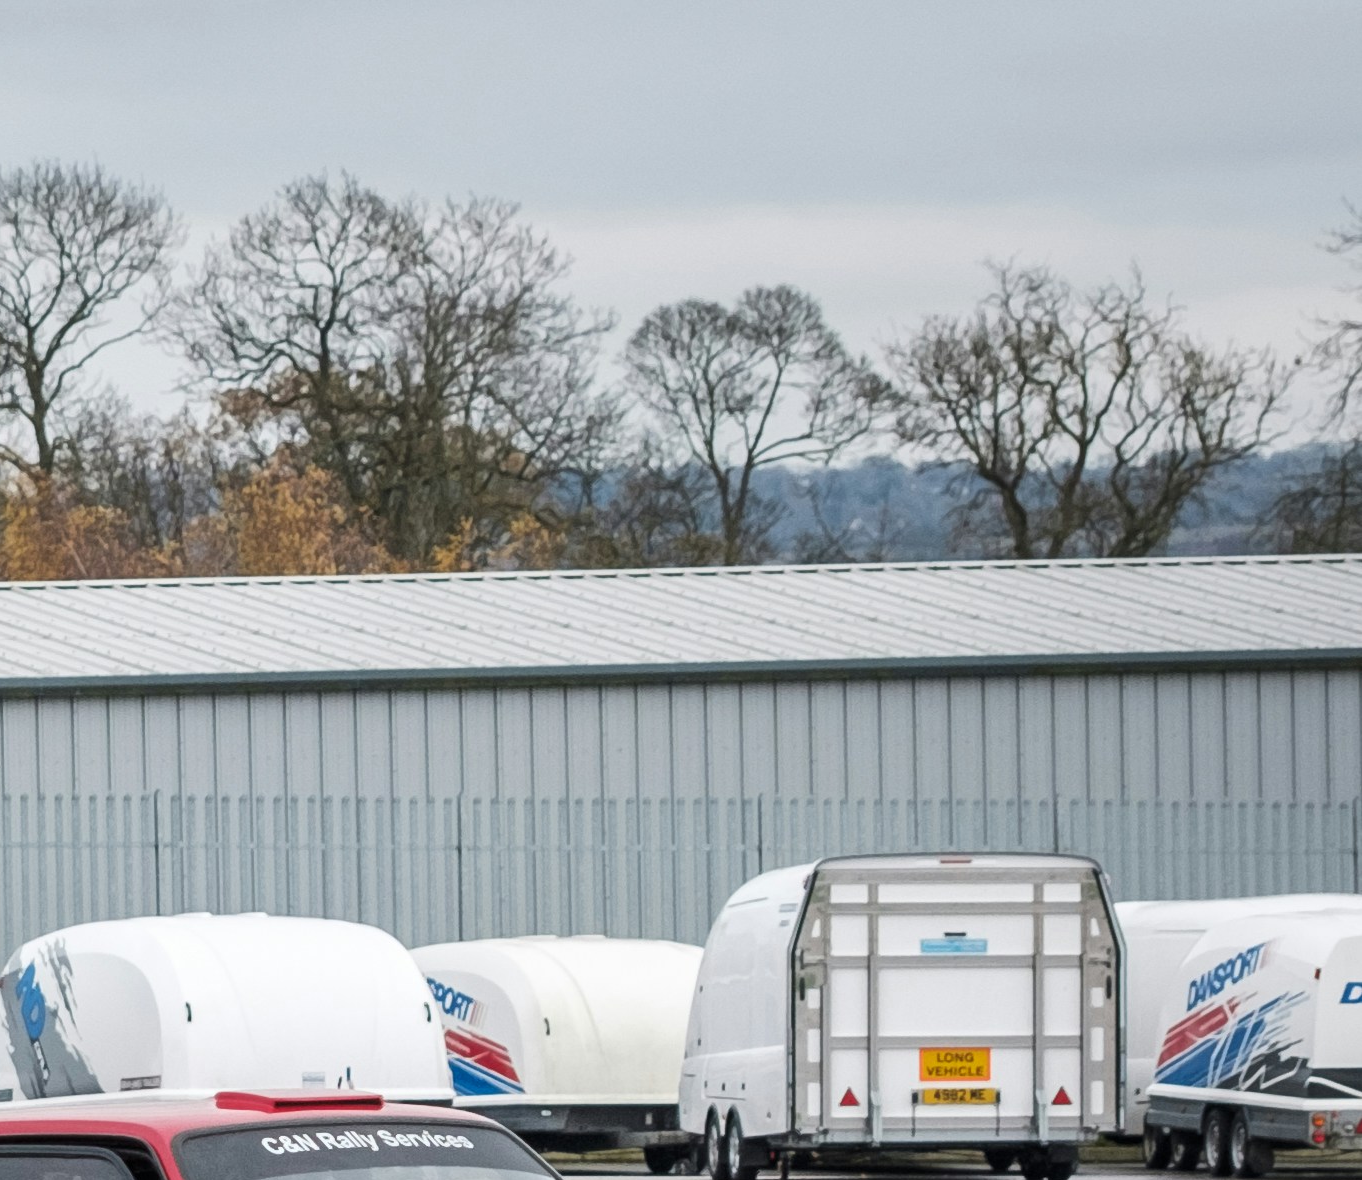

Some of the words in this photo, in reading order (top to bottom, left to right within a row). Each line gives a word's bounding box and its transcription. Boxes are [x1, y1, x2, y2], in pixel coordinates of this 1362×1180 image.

[1187, 943, 1265, 1011] DANSPORT
[937, 1053, 974, 1063] LONG
[927, 1066, 983, 1076] VEHICLE
[261, 1133, 319, 1155] C&N
[316, 1131, 379, 1151] Rally
[377, 1130, 474, 1149] Services
